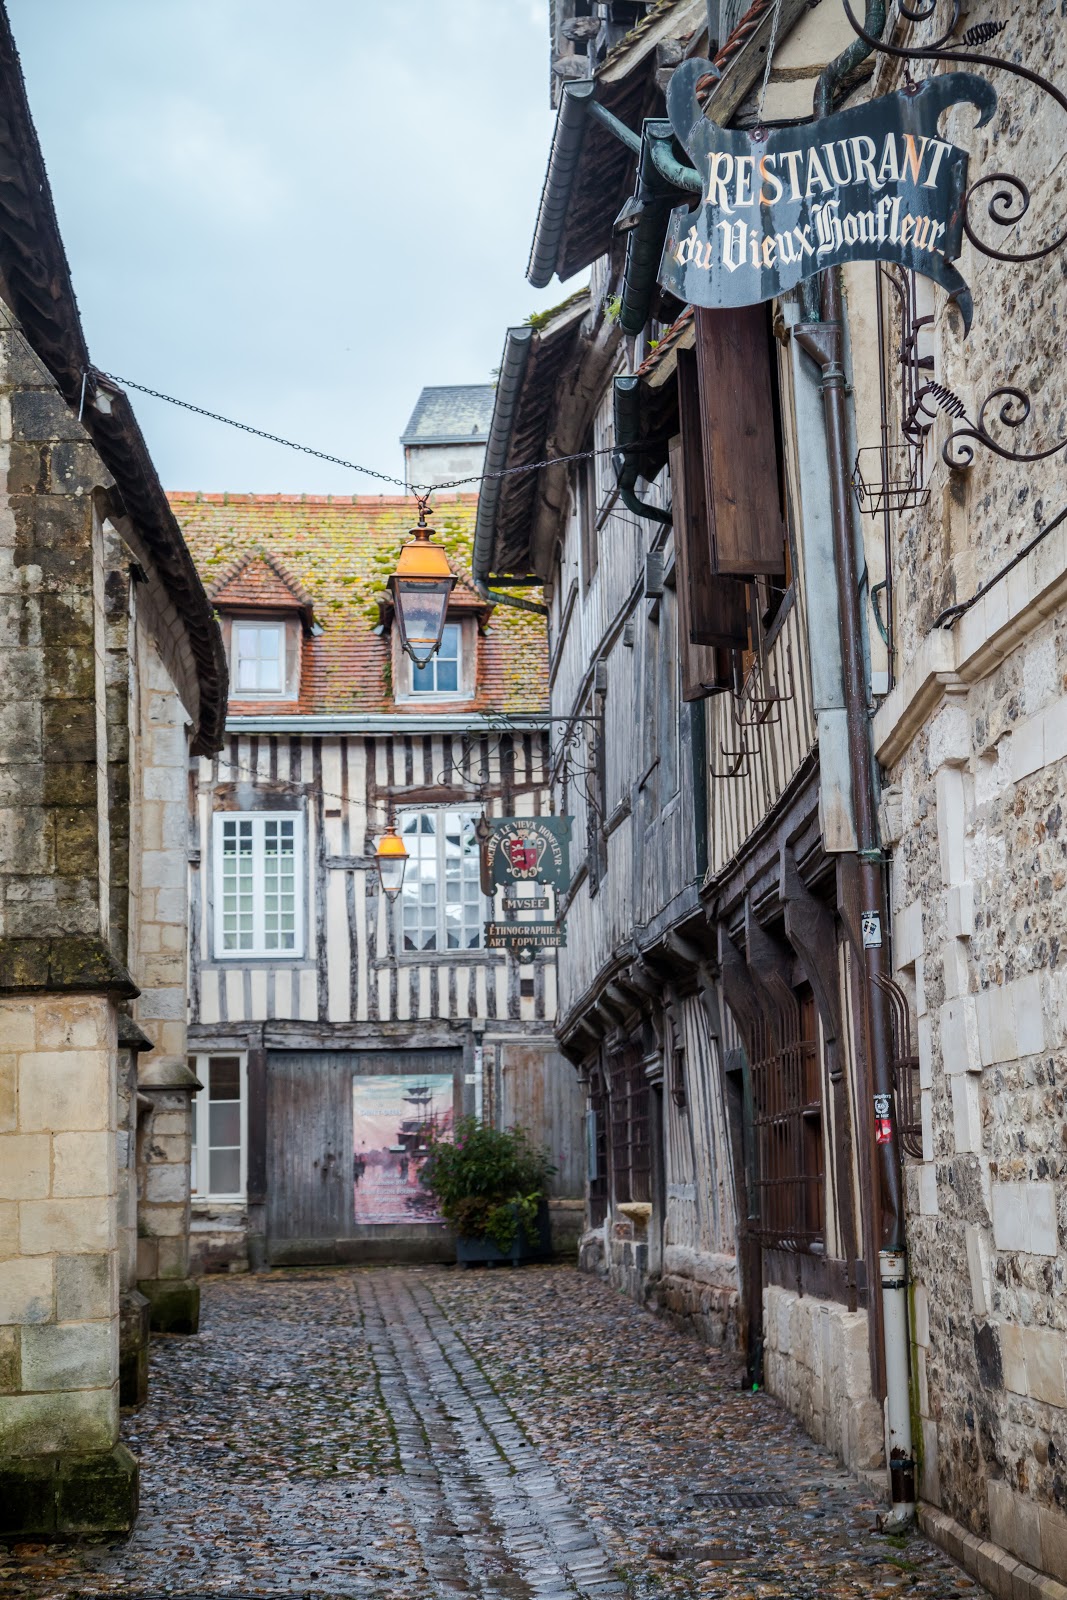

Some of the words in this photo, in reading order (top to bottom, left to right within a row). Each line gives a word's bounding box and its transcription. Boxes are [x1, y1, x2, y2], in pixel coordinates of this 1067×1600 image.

[704, 132, 953, 213] RESTAURANT
[673, 225, 713, 270] du
[716, 219, 815, 273] Vieux
[811, 194, 947, 257] Honfleur
[500, 824, 512, 835] LE
[489, 938, 507, 947] ART
